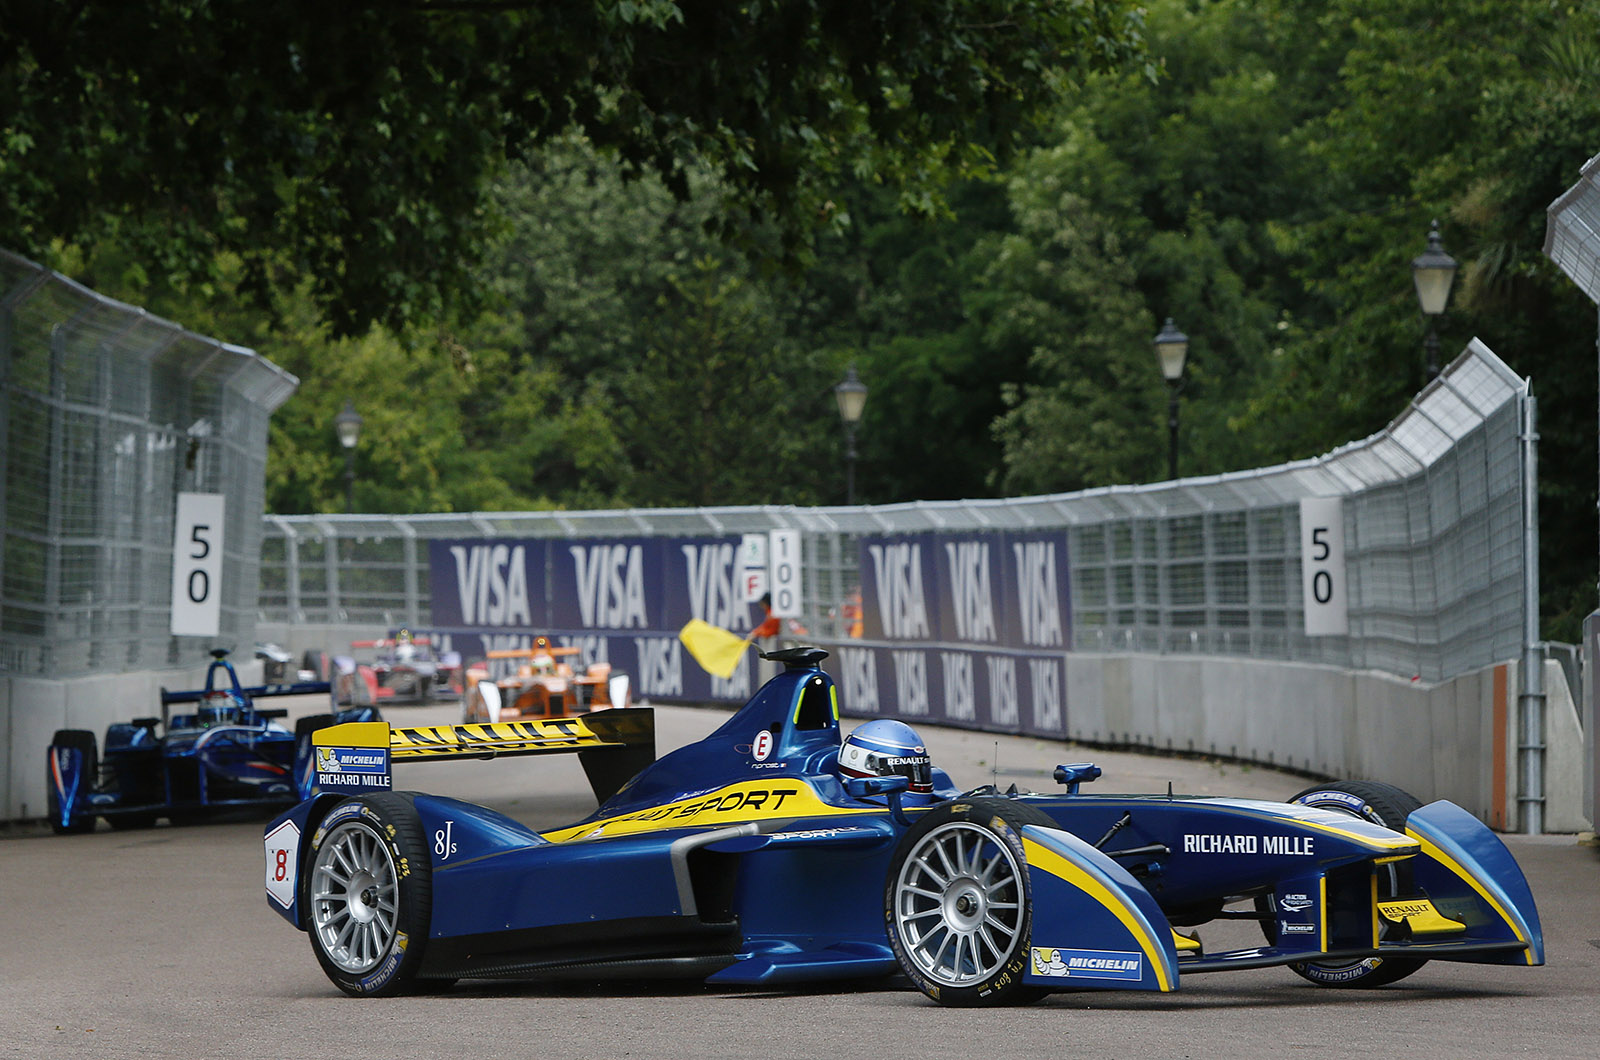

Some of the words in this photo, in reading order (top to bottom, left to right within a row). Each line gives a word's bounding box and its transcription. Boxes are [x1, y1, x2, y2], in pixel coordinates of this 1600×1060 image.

[189, 525, 210, 603] 50
[450, 545, 531, 626] VISA
[570, 544, 648, 628] VISA
[777, 536, 793, 611] 100
[869, 543, 929, 639] VISA
[945, 541, 996, 641] VISA
[1013, 541, 1063, 646] VISA
[1312, 527, 1332, 604] 50
[635, 637, 683, 696] VISA
[838, 647, 880, 713] VISA
[893, 650, 929, 716] VISA
[941, 652, 976, 721] VISA
[986, 656, 1020, 726] VISA
[1029, 659, 1062, 731] VISA
[341, 756, 384, 765] MICHELIN
[757, 736, 768, 756] E
[887, 757, 924, 766] RENAULT
[319, 774, 359, 785] RICHARD
[362, 775, 390, 787] MILLE
[671, 789, 798, 819] SPORT
[275, 849, 287, 881] 8
[1184, 834, 1257, 854] RICHARD
[1263, 836, 1314, 855] MILLE
[1382, 904, 1429, 914] RENAULT
[363, 957, 398, 990] MICHELIN
[1069, 957, 1139, 970] MICHELIN
[1309, 966, 1363, 981] MICHELIN
